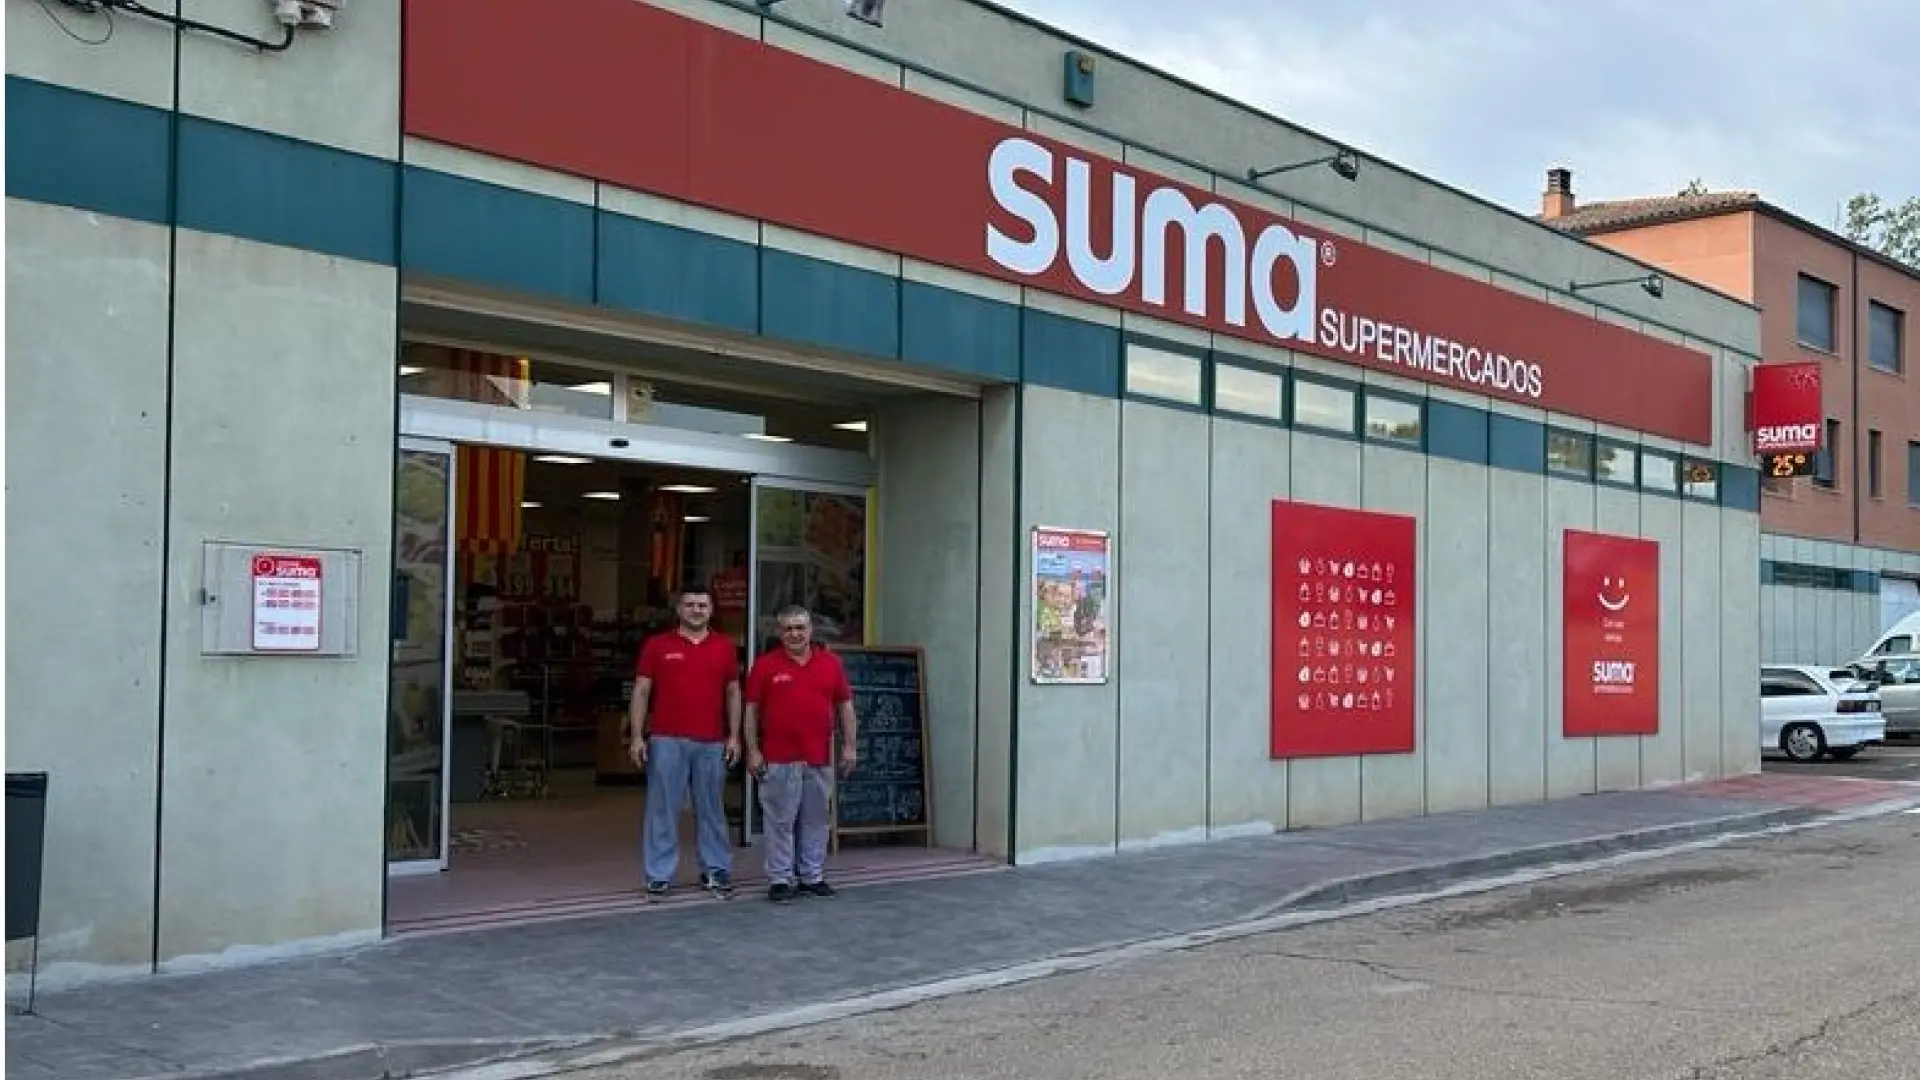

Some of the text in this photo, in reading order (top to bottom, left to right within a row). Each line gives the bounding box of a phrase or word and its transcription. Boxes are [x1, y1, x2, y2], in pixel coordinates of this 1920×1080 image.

[987, 137, 1317, 344] suma
[1320, 308, 1543, 398] SUPERMERCADOS
[1757, 424, 1816, 442] suma
[1593, 660, 1635, 683] suma
